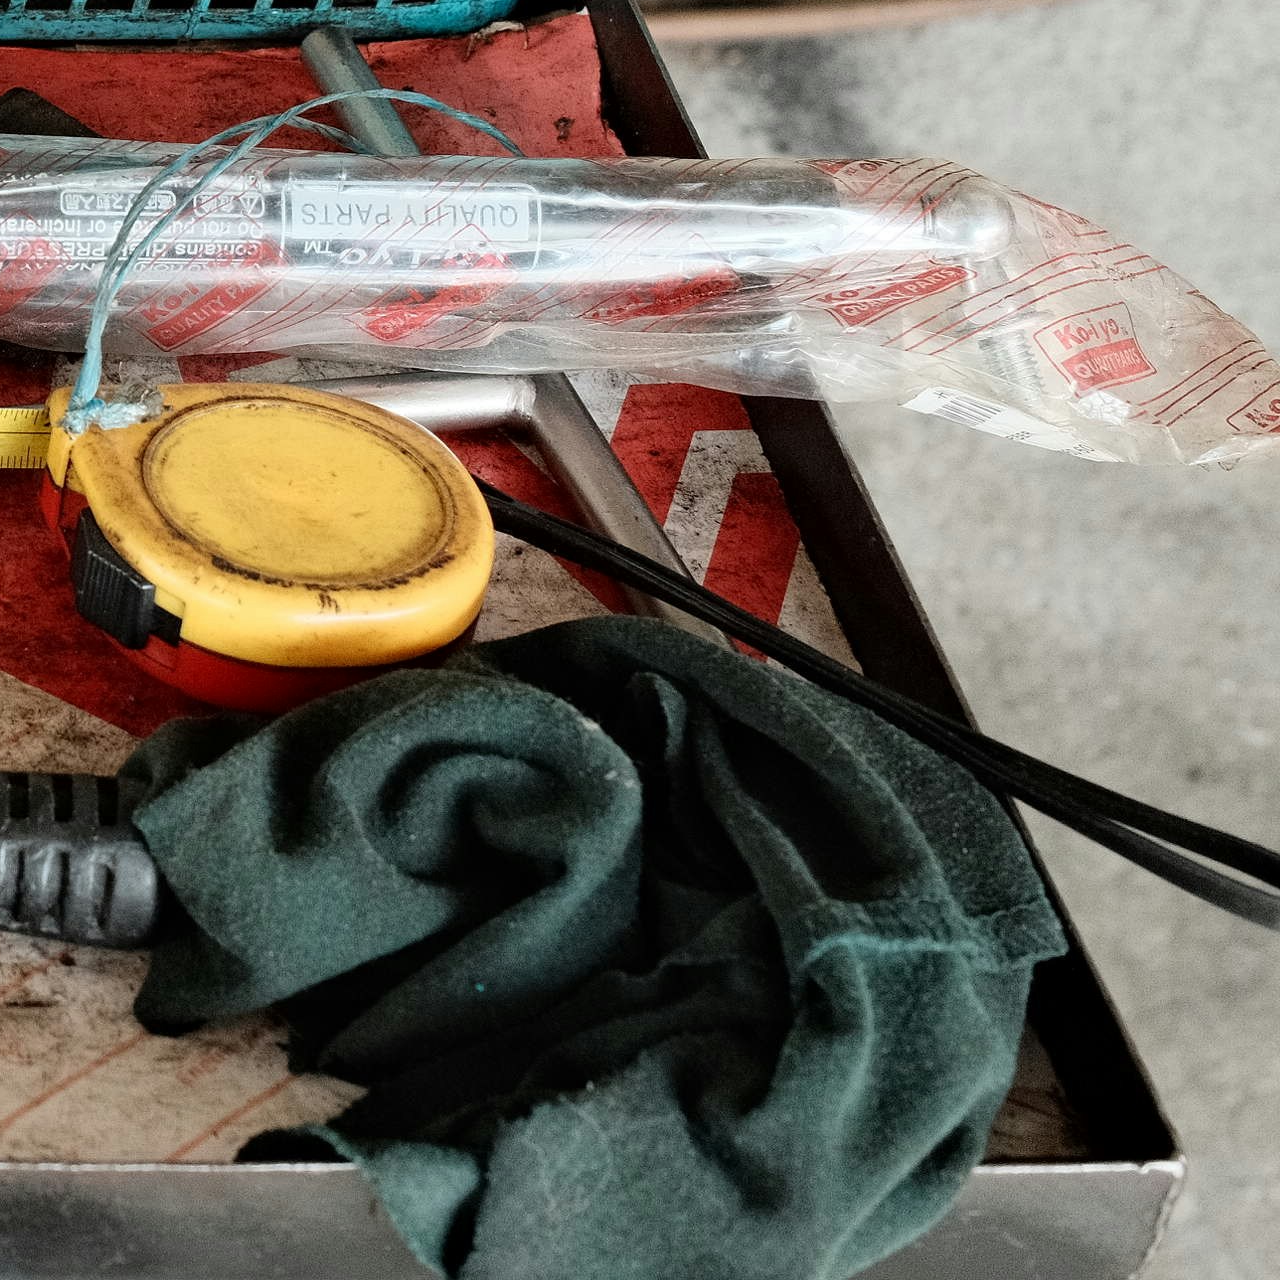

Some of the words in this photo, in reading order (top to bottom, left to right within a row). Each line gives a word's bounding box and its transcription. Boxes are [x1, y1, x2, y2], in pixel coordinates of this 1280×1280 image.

[86, 220, 106, 234] or
[300, 203, 392, 227] PARTS
[403, 203, 519, 228] QUALITY
[175, 242, 261, 259] contains
[903, 269, 955, 294] PARTS
[159, 295, 227, 340] QUALITY
